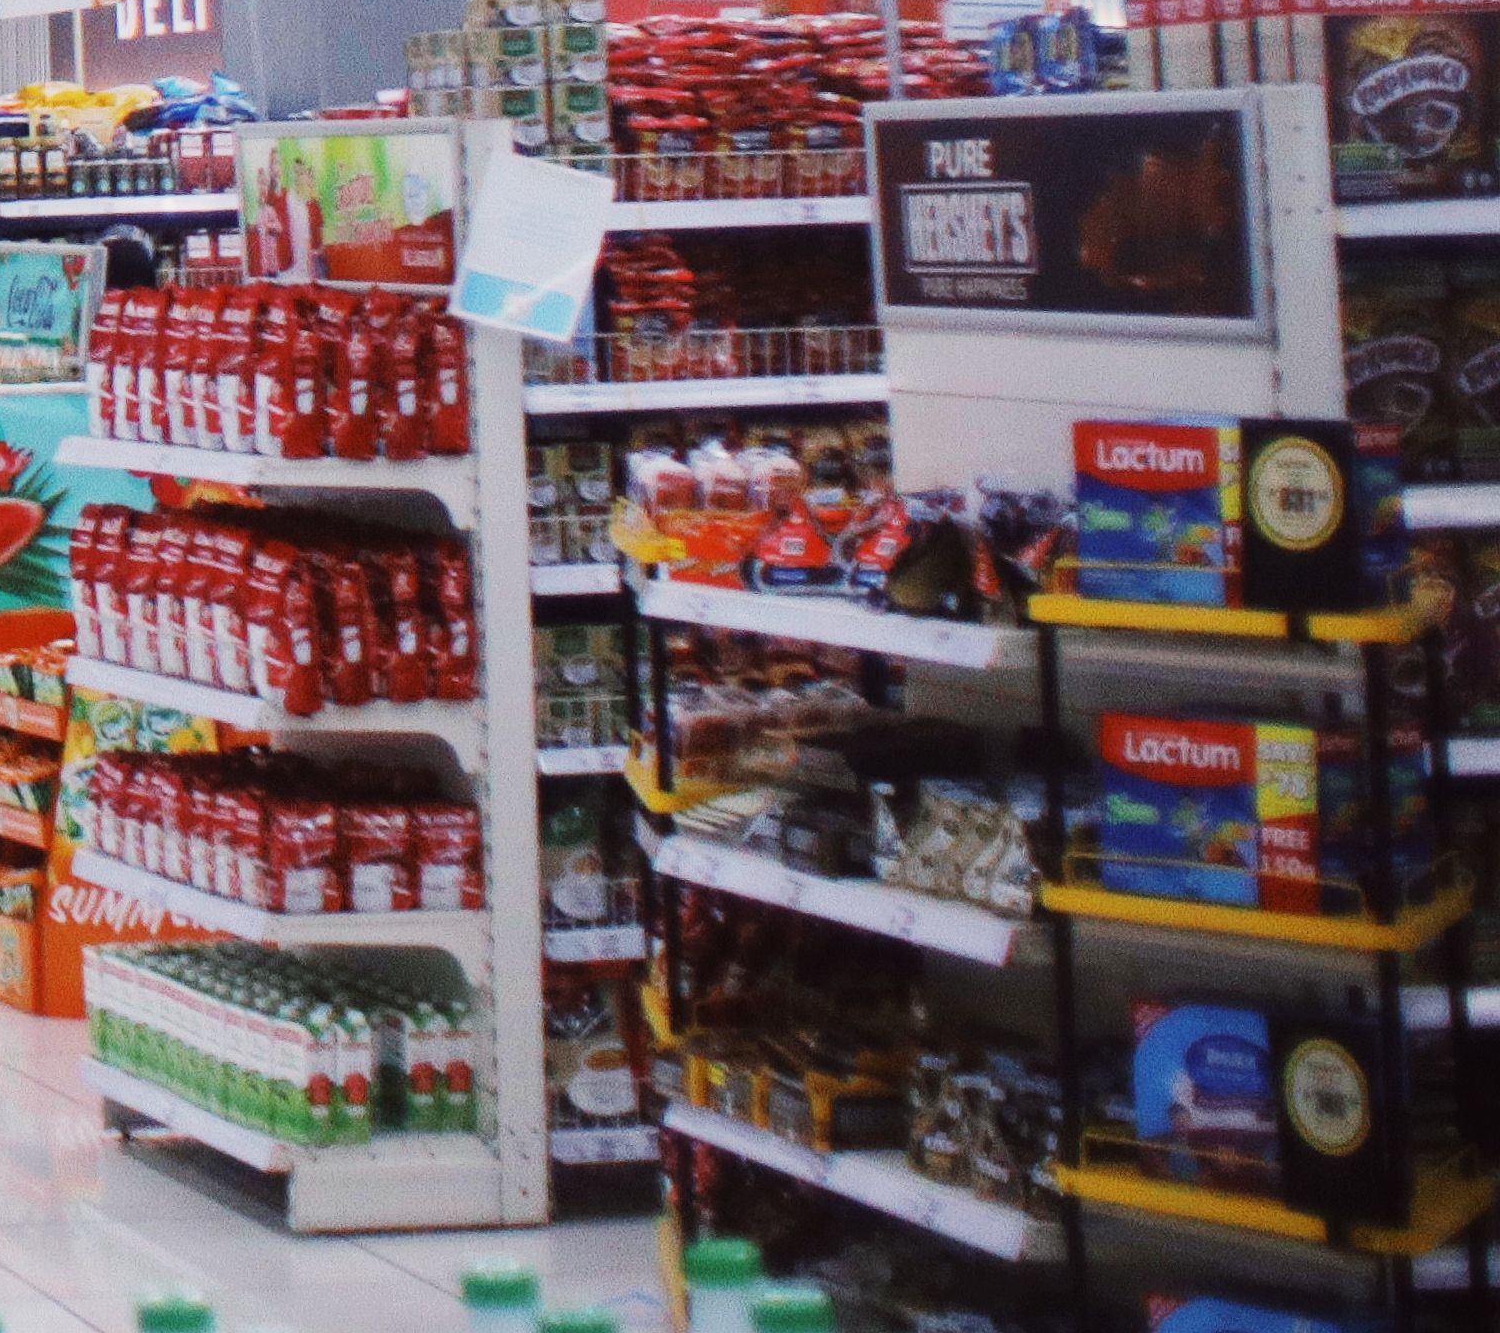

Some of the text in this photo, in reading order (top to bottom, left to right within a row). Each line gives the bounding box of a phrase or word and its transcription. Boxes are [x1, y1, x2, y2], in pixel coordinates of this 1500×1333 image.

[928, 138, 993, 178] PURE
[1095, 437, 1206, 474] Lactum
[1123, 730, 1242, 772] Lactum
[1260, 825, 1311, 851] FREE
[48, 884, 203, 935] SUMM
